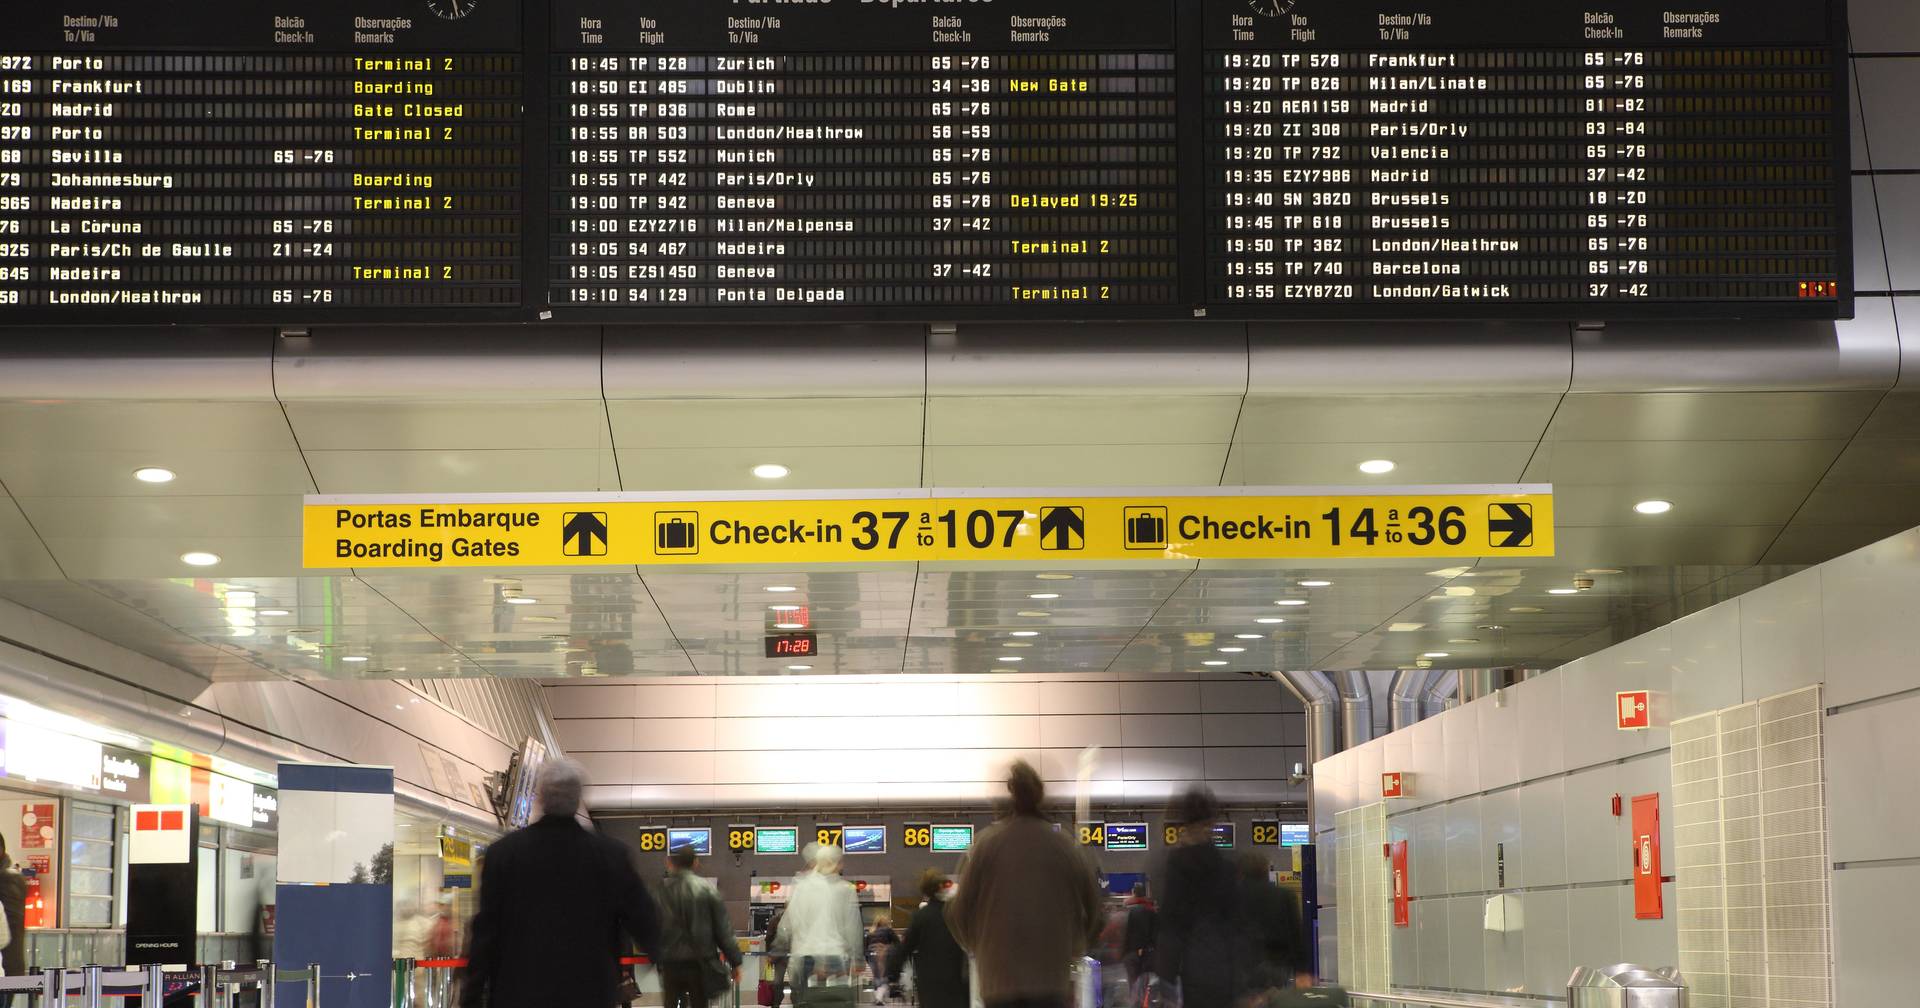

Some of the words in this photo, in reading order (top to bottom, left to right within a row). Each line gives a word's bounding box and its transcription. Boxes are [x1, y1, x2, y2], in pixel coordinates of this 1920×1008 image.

[274, 16, 305, 29] Balcão
[354, 16, 412, 32] Observações
[580, 16, 602, 29] Hora
[639, 16, 657, 29] Voo
[932, 15, 962, 28] Balcão
[1010, 15, 1067, 30] Observações
[1232, 14, 1253, 27] Hora
[1291, 14, 1308, 26] Voo
[1584, 11, 1614, 24] Balcão
[1663, 11, 1720, 26] Observações
[274, 30, 314, 43] Check-In
[354, 31, 394, 44] Remarks
[580, 31, 603, 44] Time
[639, 31, 665, 46] Flight
[932, 30, 971, 43] Check-In
[1010, 29, 1050, 42] Remarks
[1232, 28, 1255, 41] Time
[1291, 28, 1316, 43] Flight
[1584, 26, 1623, 39] Check-In
[1663, 25, 1703, 38] Remarks
[571, 57, 618, 71] 18:45
[629, 57, 648, 71] TP
[658, 57, 687, 71] 928
[717, 57, 775, 71] Zurich
[931, 56, 951, 70] 65
[961, 56, 990, 70] -76
[3, 79, 32, 93] 169
[52, 79, 142, 93] Frankfurt
[354, 81, 433, 96] Boarding
[571, 80, 618, 94] 18:50
[628, 80, 648, 94] EI
[658, 80, 687, 94] 485
[716, 80, 775, 94] Dublin
[932, 79, 951, 93] 34
[961, 79, 990, 92] -36
[1010, 79, 1039, 92] New
[1049, 78, 1087, 92] Gate
[1224, 77, 1271, 91] 19:20
[1282, 77, 1301, 91] TP
[1310, 77, 1340, 91] 826
[1369, 76, 1487, 90] Milan/Linate
[1585, 75, 1605, 89] 65
[1614, 75, 1644, 89] -76
[52, 103, 113, 117] Madrid
[354, 104, 393, 117] Gate
[404, 104, 463, 117] Closed
[1225, 100, 1271, 114] 19:20
[1370, 99, 1428, 113] Madrid
[1586, 98, 1603, 112] 81
[1615, 98, 1645, 112] -82
[571, 126, 618, 140] 18:55
[628, 126, 648, 140] BA
[657, 126, 687, 140] 503
[717, 126, 863, 140] London/Heathrow
[932, 125, 952, 139] 56
[961, 125, 991, 138] -59
[1225, 123, 1272, 137] 19:20
[1282, 123, 1301, 137] ZI
[1311, 123, 1340, 136] 308
[1370, 122, 1468, 138] Paris/Orly
[1586, 122, 1605, 135] 83
[1616, 121, 1645, 135] -84
[51, 149, 122, 163] Sevilla
[274, 149, 294, 164] 65
[304, 150, 334, 163] -76
[0, 172, 21, 187] 79
[51, 173, 173, 189] Johannesburg
[353, 173, 432, 188] Boarding
[571, 196, 618, 209] 19:00
[629, 196, 648, 209] TP
[658, 195, 687, 209] 942
[717, 195, 775, 209] Geneva
[932, 194, 952, 208] 65
[962, 194, 991, 208] -76
[1010, 194, 1079, 209] Delayed
[1091, 193, 1137, 207] 19:25
[1226, 192, 1273, 206] 19:40
[1283, 192, 1302, 206] SN
[1312, 192, 1351, 206] 3820
[1371, 192, 1449, 206] Brussels
[1589, 191, 1607, 204] 18
[1617, 191, 1646, 204] -20
[50, 220, 70, 234] La
[273, 220, 293, 233] 65
[303, 219, 333, 233] -76
[571, 219, 618, 233] 19:00
[628, 219, 697, 233] EZY2716
[717, 218, 853, 234] Milan/Malpensa
[933, 217, 952, 231] 37
[962, 217, 991, 231] -42
[0, 243, 29, 257] 925
[50, 243, 131, 257] Paris/Ch
[141, 243, 162, 257] de
[172, 243, 232, 257] Gaulle
[272, 243, 290, 257] 21
[303, 243, 333, 257] -24
[49, 290, 201, 304] London/Heathrow
[272, 289, 292, 303] 65
[303, 289, 332, 303] -76
[571, 288, 618, 302] 19:10
[629, 288, 648, 302] S4
[659, 288, 687, 302] 129
[717, 288, 766, 302] Ponta
[776, 287, 845, 303] Delgada
[1012, 286, 1088, 300] Terminal
[1101, 286, 1109, 299] 2
[1227, 285, 1274, 298] 19:55
[1285, 285, 1353, 298] EZY8720
[1373, 284, 1510, 298] London/Gatwick
[1589, 283, 1609, 297] 37
[1619, 283, 1648, 297] -42
[336, 509, 412, 529] Portas
[420, 508, 540, 532] Embarque
[920, 512, 930, 524] a
[1388, 509, 1399, 521] a
[709, 519, 842, 545] Check-in
[851, 511, 910, 551] 37
[938, 509, 1025, 549] 107
[1178, 514, 1311, 541] Check-in
[1322, 507, 1379, 546] 14
[1407, 505, 1467, 546] 36
[916, 532, 934, 546] to
[1384, 529, 1403, 543] to
[336, 538, 443, 562] Boarding
[451, 537, 520, 557] Gates
[776, 639, 810, 653] 17:28
[640, 832, 666, 851] 89
[729, 830, 754, 849] 88
[817, 829, 842, 847] 87
[904, 828, 930, 846] 86
[1079, 826, 1104, 844] 84
[1253, 826, 1278, 844] 82
